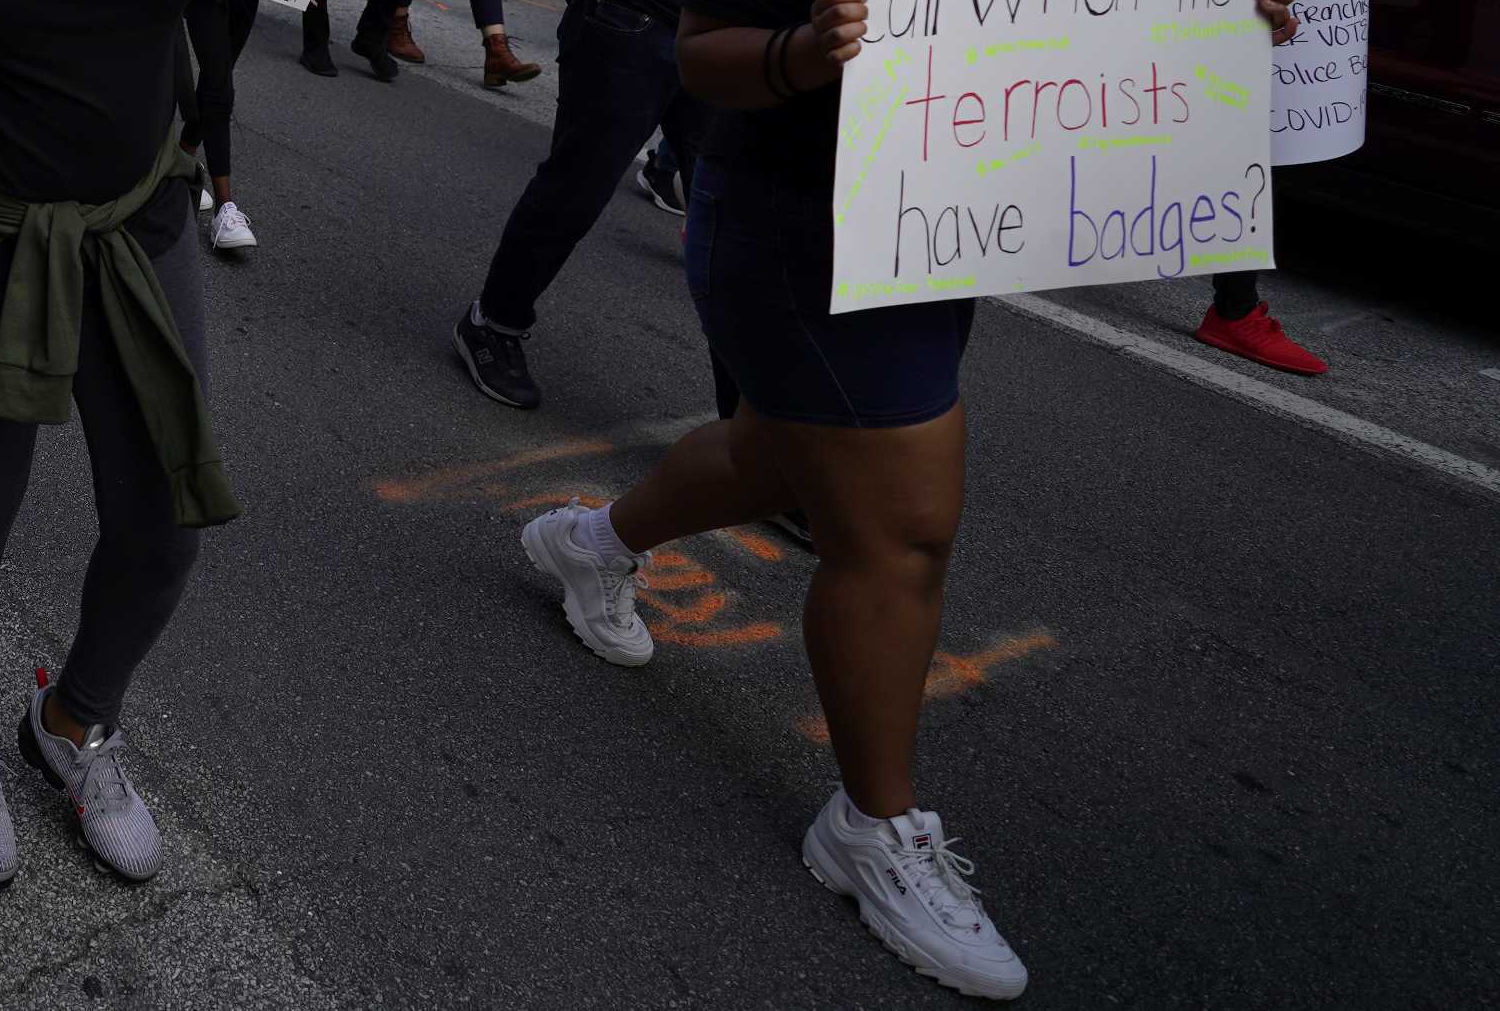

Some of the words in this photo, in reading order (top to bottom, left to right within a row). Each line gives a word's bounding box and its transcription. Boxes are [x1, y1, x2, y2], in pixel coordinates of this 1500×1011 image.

[905, 44, 1190, 161] terroists
[893, 169, 1026, 278] have
[1066, 153, 1266, 279] badges?
[885, 867, 908, 896] FILA
